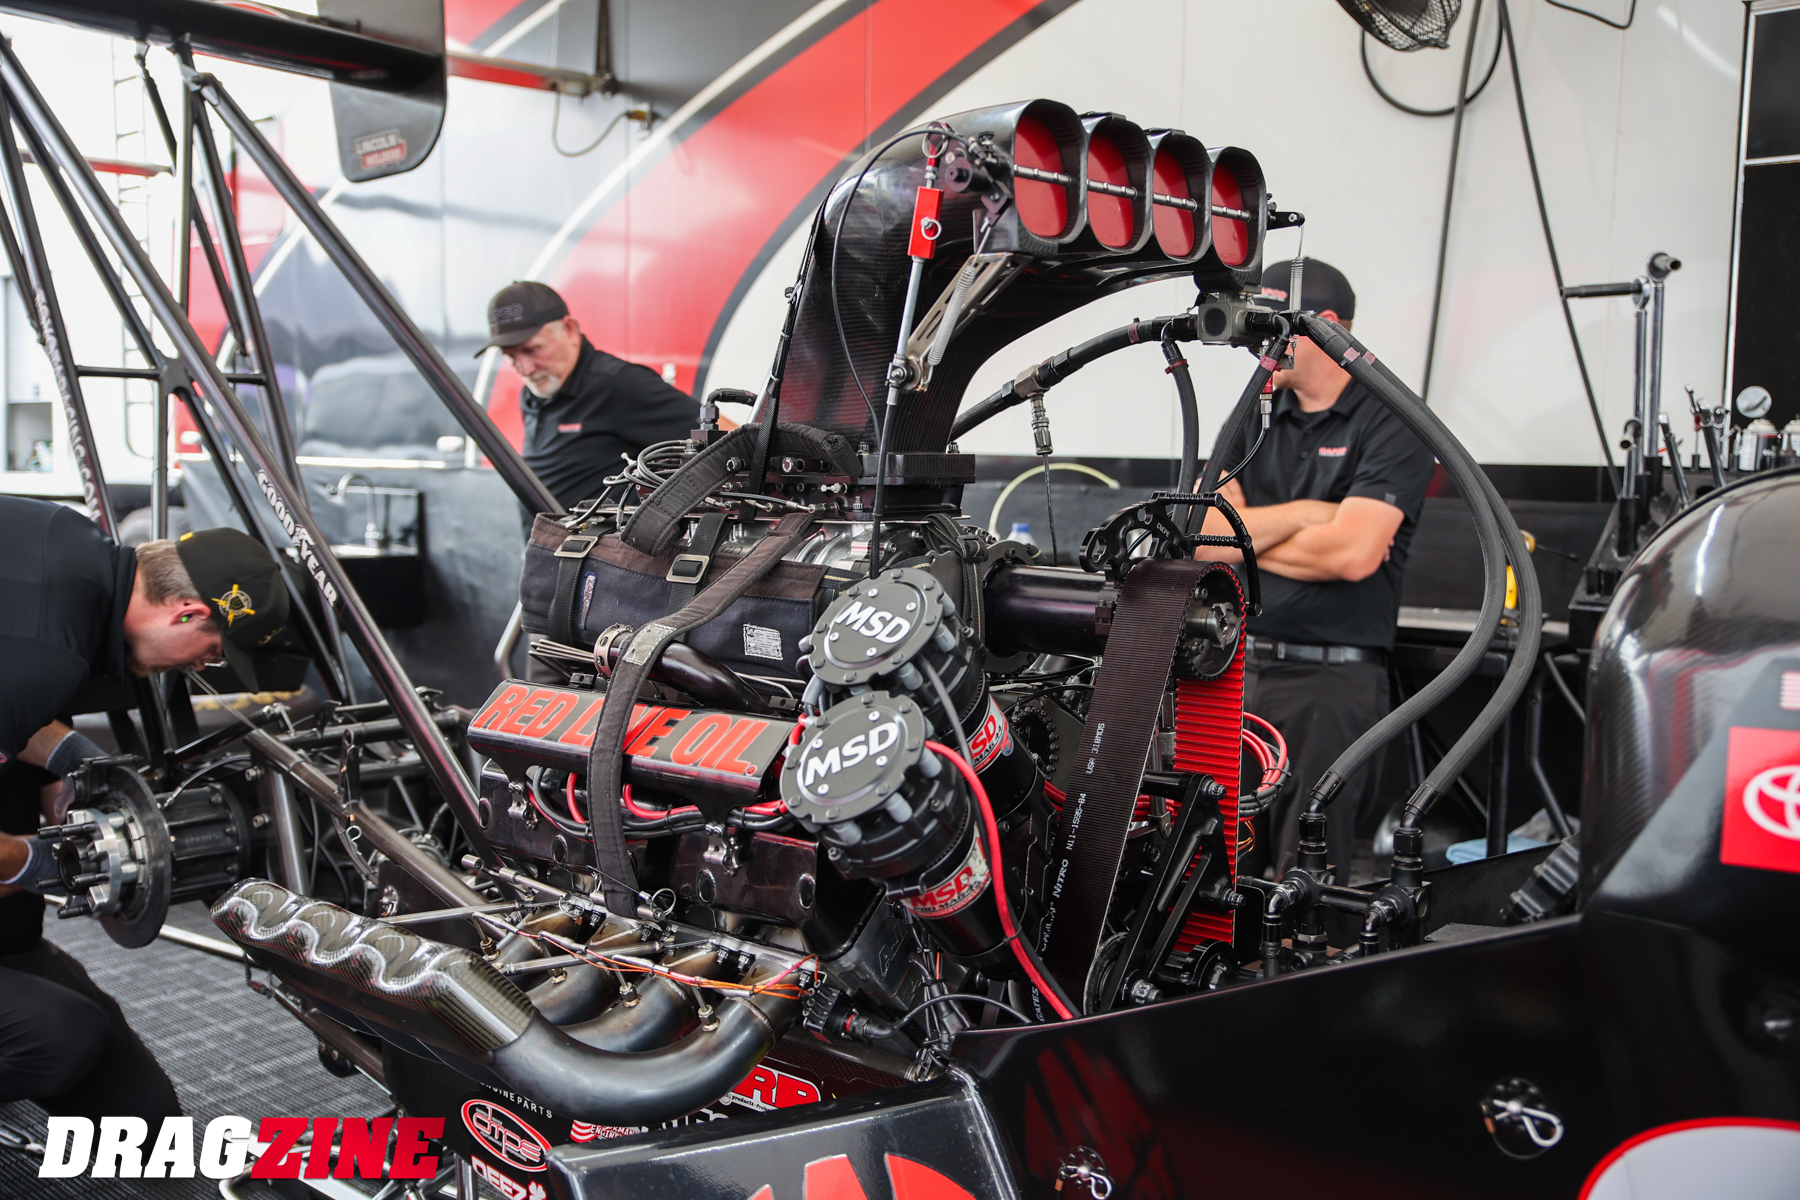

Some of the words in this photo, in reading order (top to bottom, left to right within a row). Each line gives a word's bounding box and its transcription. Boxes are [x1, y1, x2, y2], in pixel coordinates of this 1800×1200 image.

[355, 132, 398, 155] LINCOLN
[257, 470, 337, 607] GOODYEAR
[834, 600, 912, 645] MSD
[472, 684, 579, 739] RED
[559, 697, 691, 757] LNE
[968, 714, 997, 760] SD
[803, 721, 901, 788] MSD
[909, 865, 973, 908] MSD
[938, 891, 968, 909] MAG
[1052, 858, 1069, 899] NITRO
